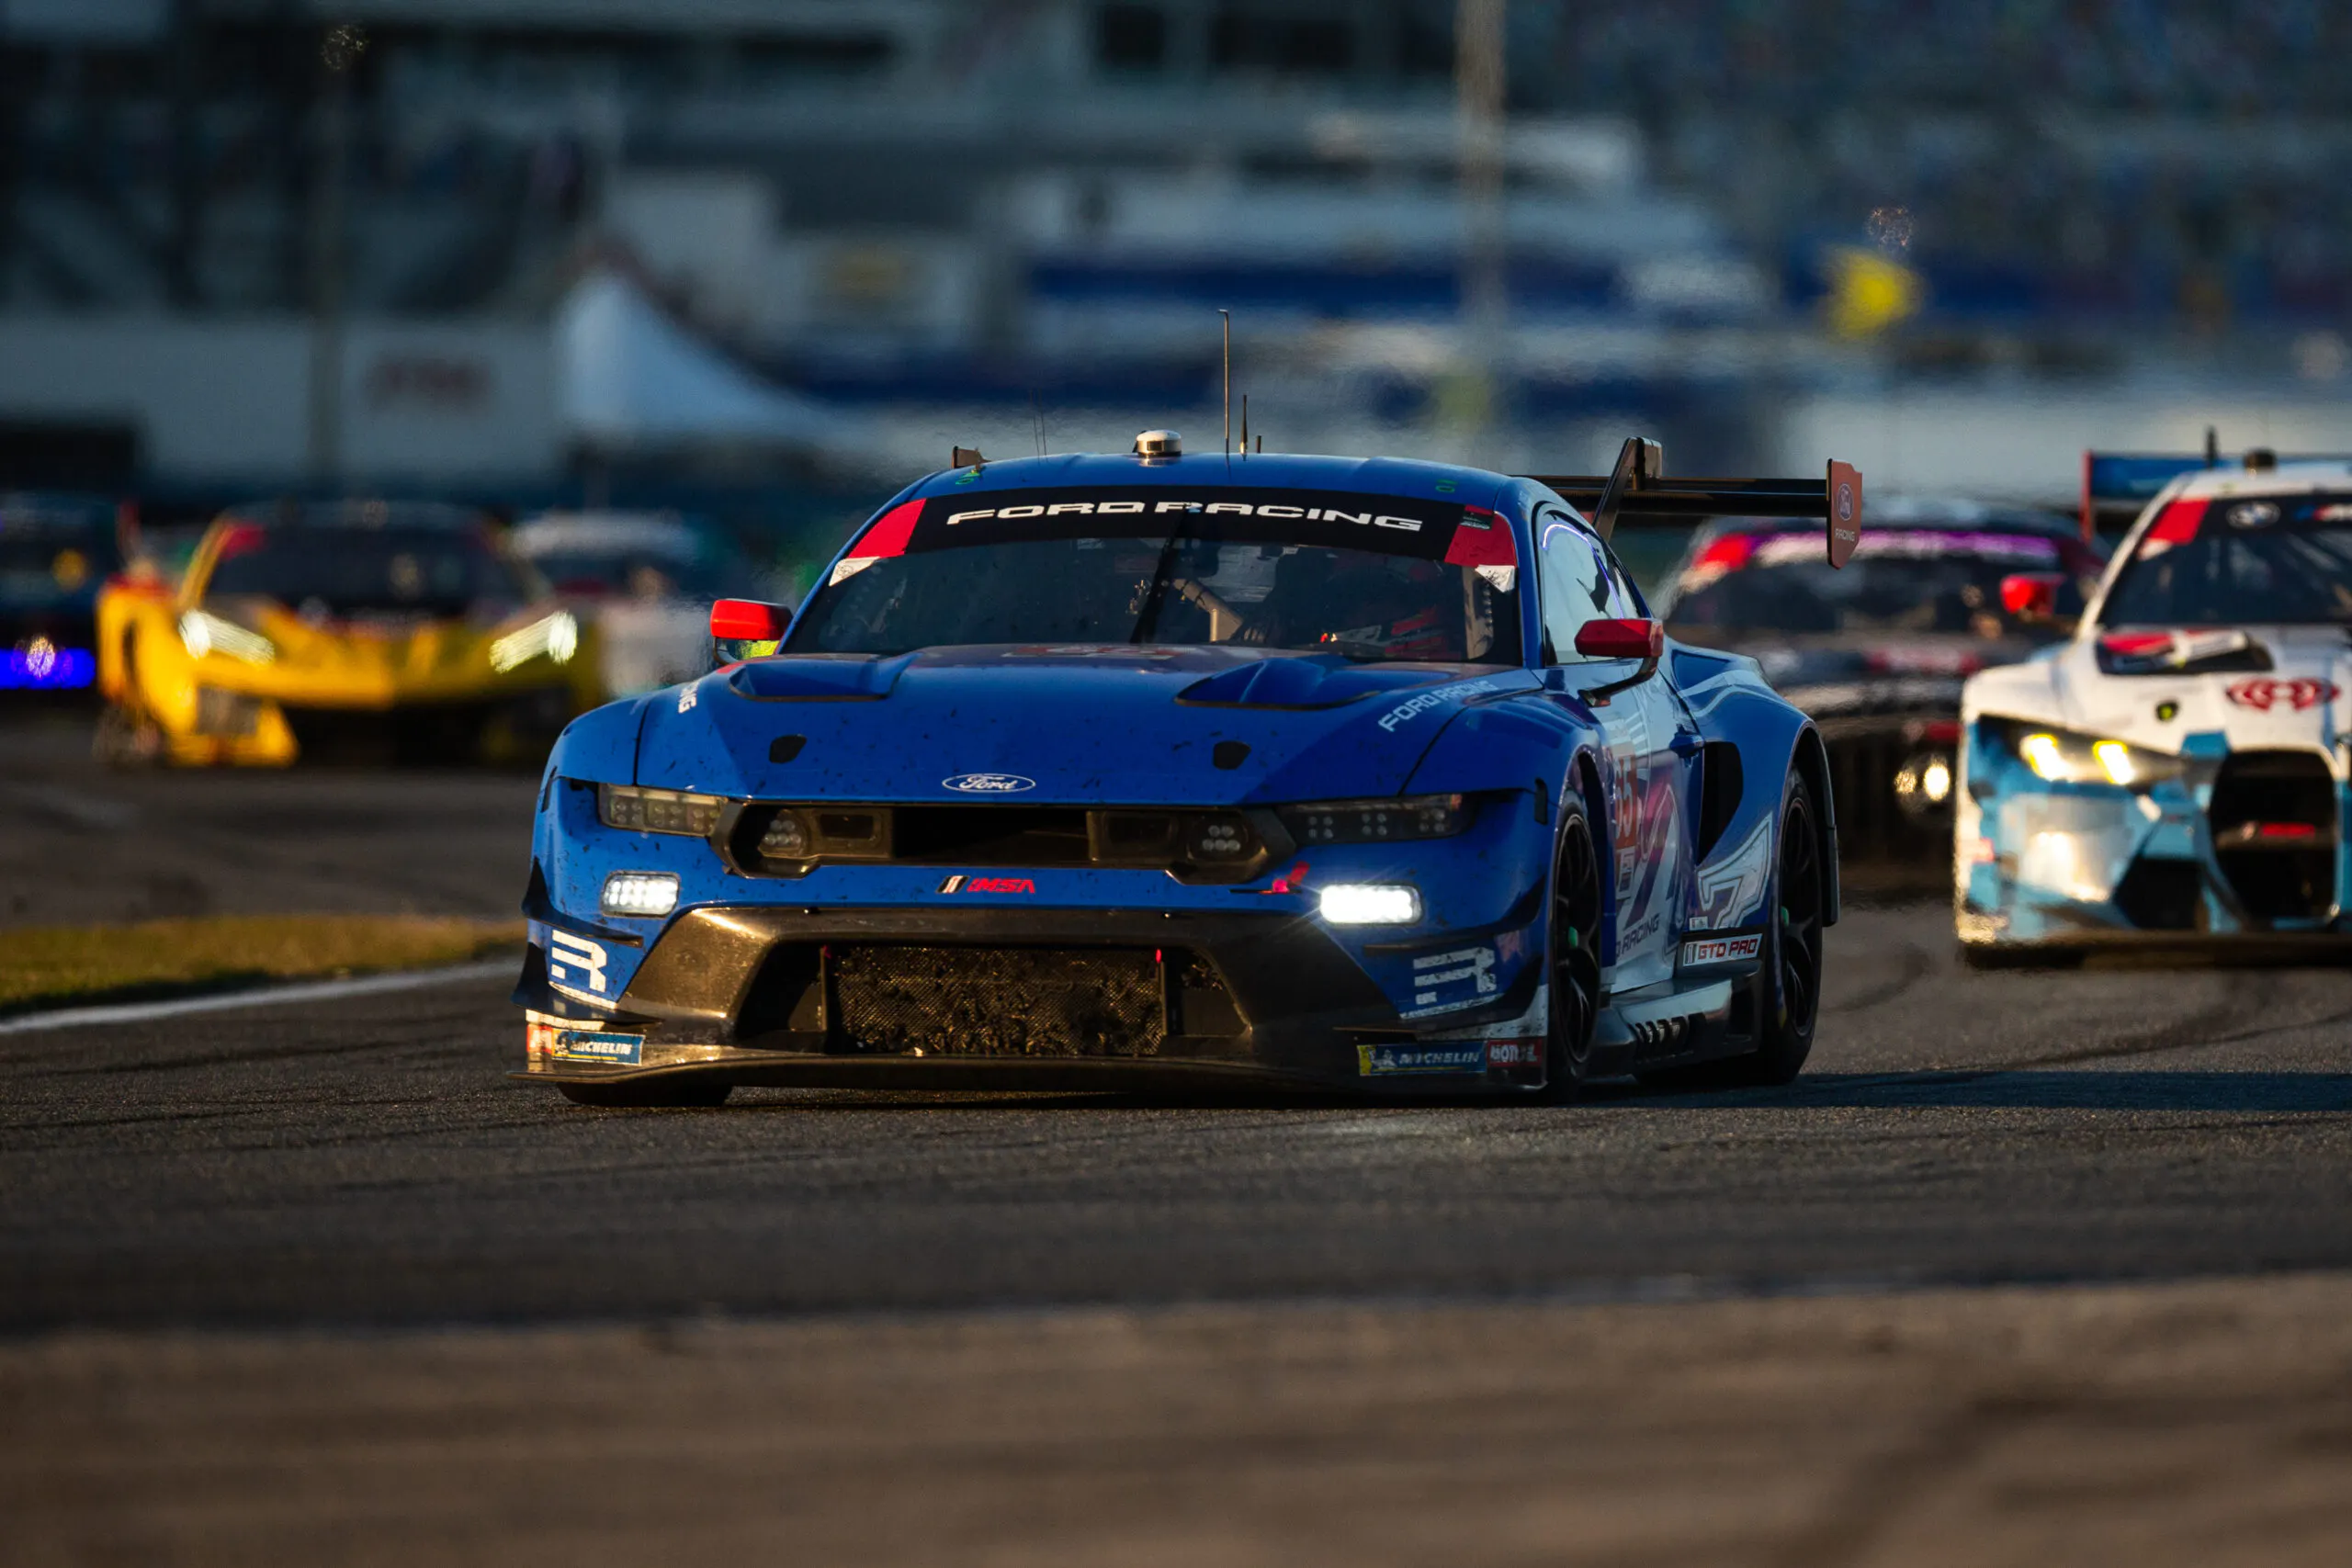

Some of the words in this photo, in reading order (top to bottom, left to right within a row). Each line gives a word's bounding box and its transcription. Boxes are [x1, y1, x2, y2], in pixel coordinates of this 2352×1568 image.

[946, 502, 1145, 525] FORD
[1154, 502, 1423, 532] RACING
[1378, 694, 1441, 733] FORD
[1431, 681, 1499, 702] RACING
[957, 774, 1019, 791] Ford
[967, 877, 1036, 894] IMSA
[1698, 942, 1727, 960] GTD
[1729, 938, 1758, 956] PRO
[570, 1040, 633, 1055] MICHELIN
[1398, 1051, 1480, 1066] MICHELIN
